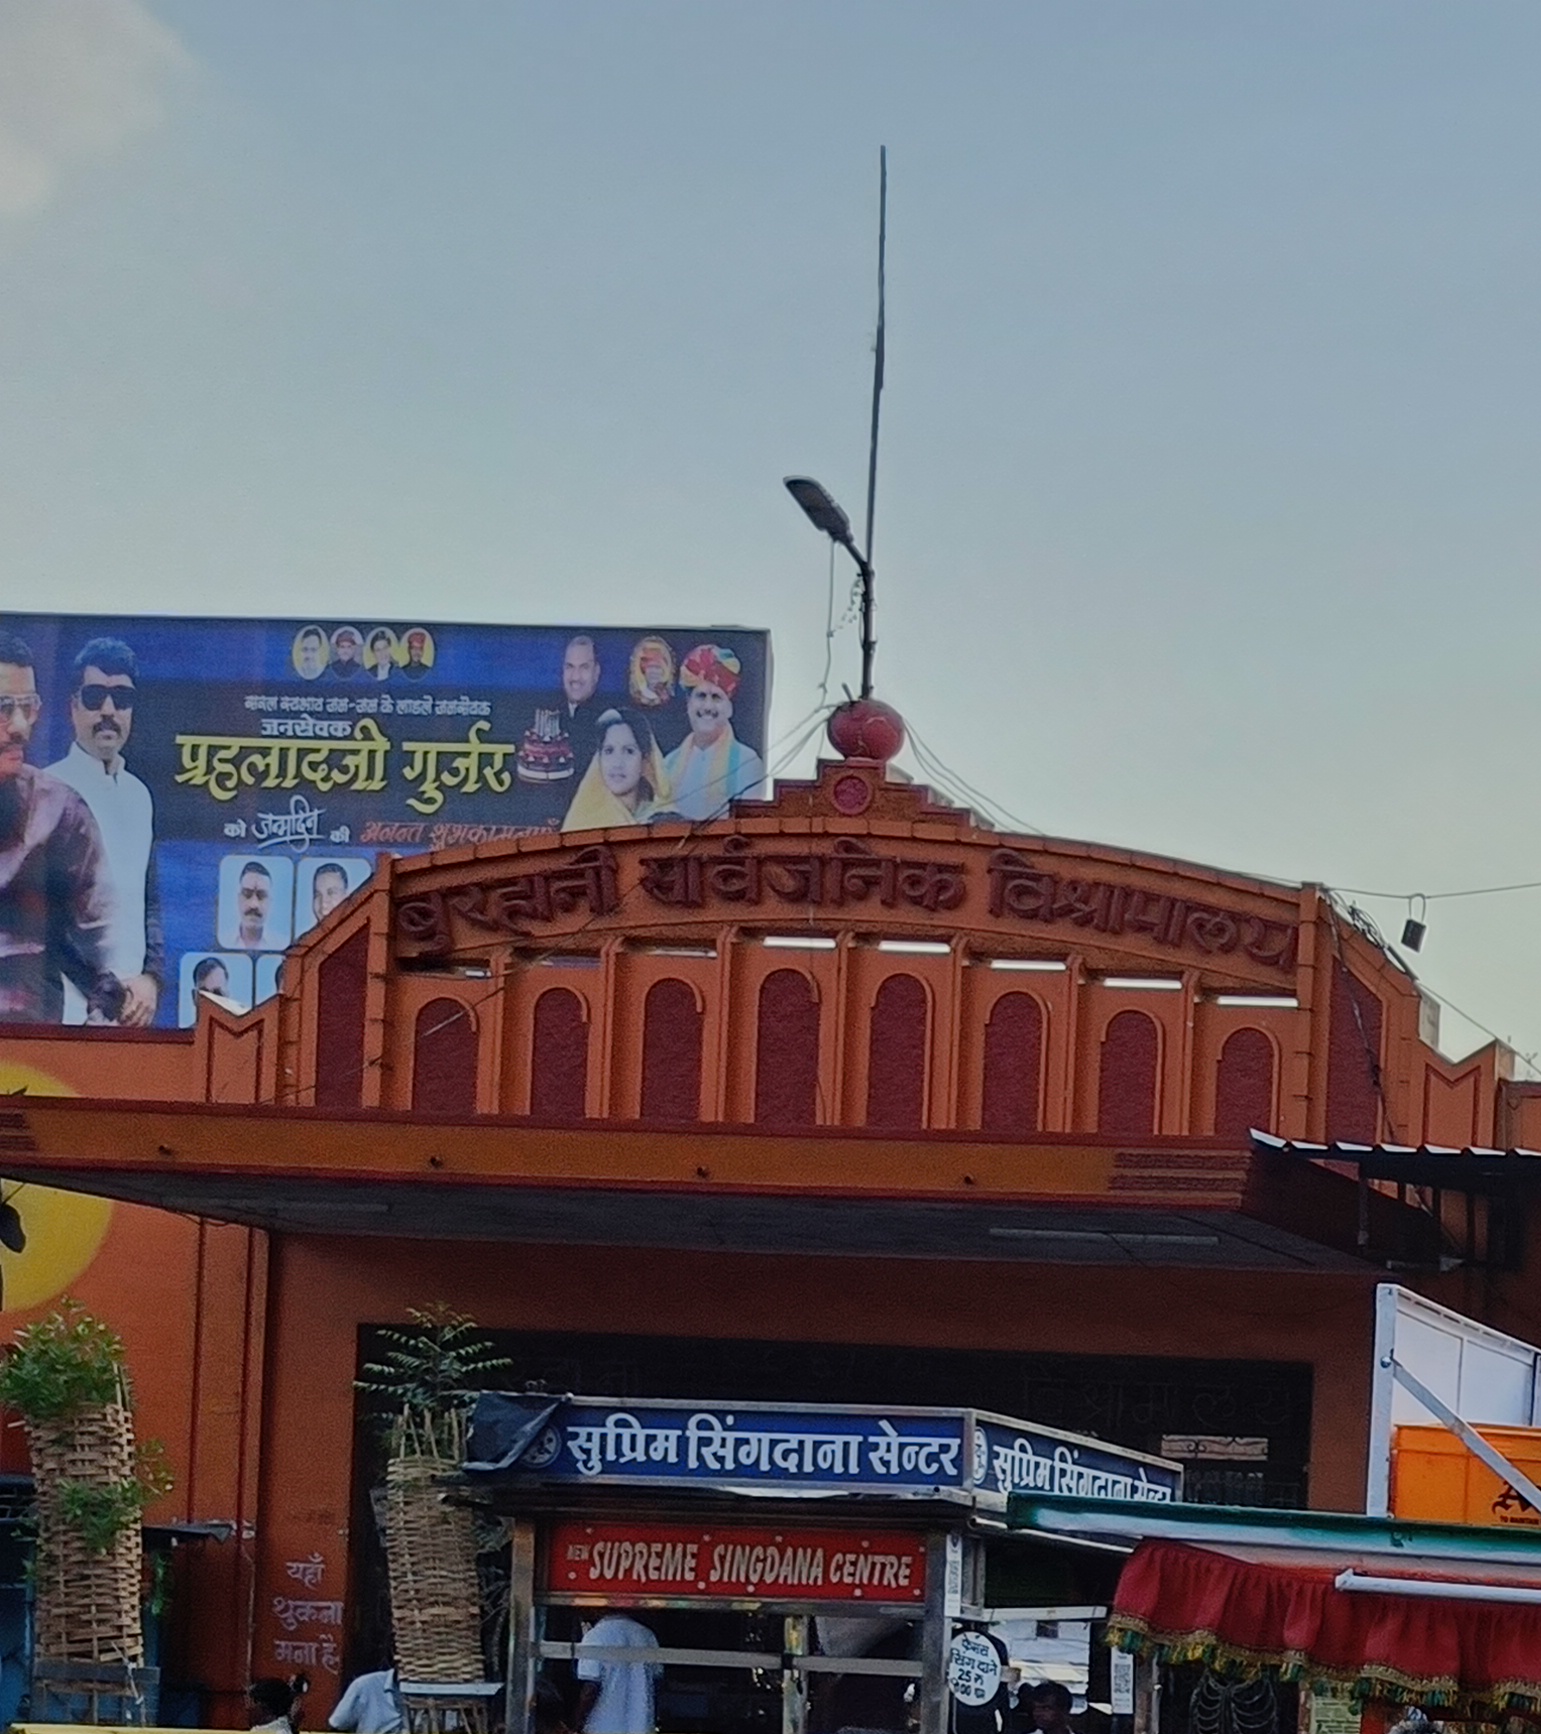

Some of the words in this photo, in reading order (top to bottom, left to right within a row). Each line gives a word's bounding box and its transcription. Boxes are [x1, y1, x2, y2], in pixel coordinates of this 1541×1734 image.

[261, 713, 353, 738] जनसेवक
[174, 717, 391, 800] प्रहलादजी
[400, 720, 516, 814] गुर्जर
[223, 820, 247, 839] को
[252, 795, 327, 853] जन्मदिन
[329, 827, 350, 845] की
[640, 835, 967, 912] सार्वजनिक
[566, 1413, 682, 1475] सुप्रिम
[686, 1413, 863, 1475] सिंगदाना
[867, 1419, 961, 1476] सेन्टर
[992, 1437, 1053, 1494] सुप्रिम
[285, 1551, 326, 1592] यहाँ
[566, 1545, 590, 1560] NEW
[589, 1542, 698, 1583] SUPREME
[710, 1544, 823, 1586] SINGDANA
[829, 1553, 913, 1589] CENTRE
[274, 1639, 321, 1666] मना
